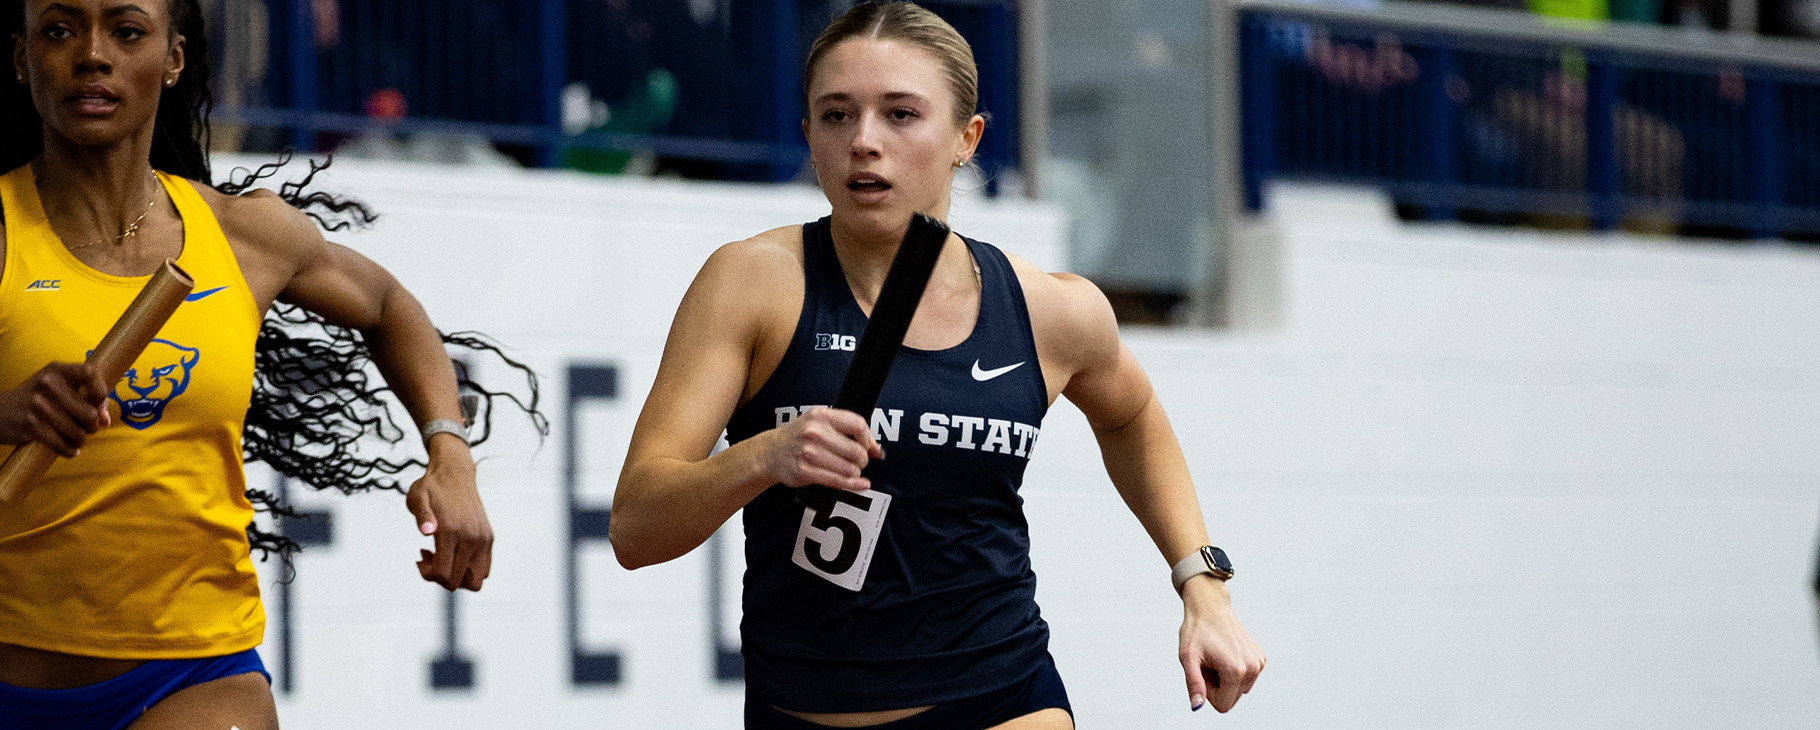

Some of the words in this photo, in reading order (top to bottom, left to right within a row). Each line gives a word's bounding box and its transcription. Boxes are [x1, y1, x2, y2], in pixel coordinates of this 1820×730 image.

[26, 280, 61, 289] ACC
[775, 405, 904, 442] PN
[804, 489, 873, 574] 5
